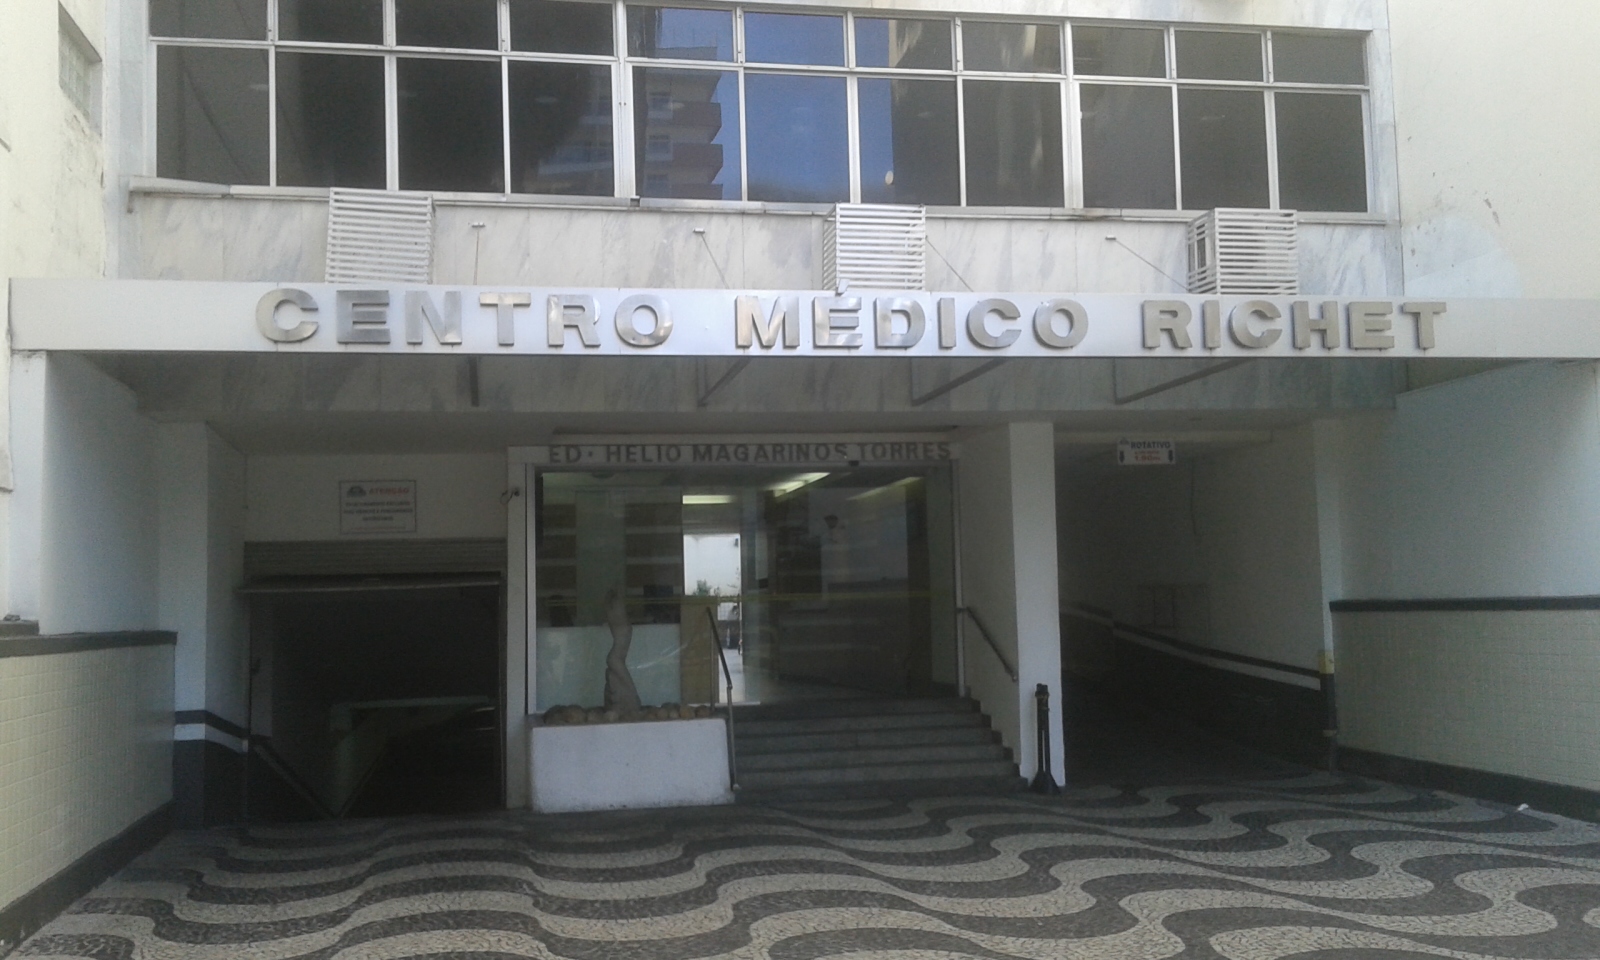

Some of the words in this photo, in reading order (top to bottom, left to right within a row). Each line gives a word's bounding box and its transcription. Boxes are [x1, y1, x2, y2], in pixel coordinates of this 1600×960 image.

[255, 287, 674, 348] CENTRO
[1142, 299, 1448, 351] RICHET
[605, 444, 682, 463] HELIO
[692, 442, 848, 463] MAGARINOS
[858, 441, 950, 461] TORRES
[1130, 441, 1171, 449] ROTATIVO
